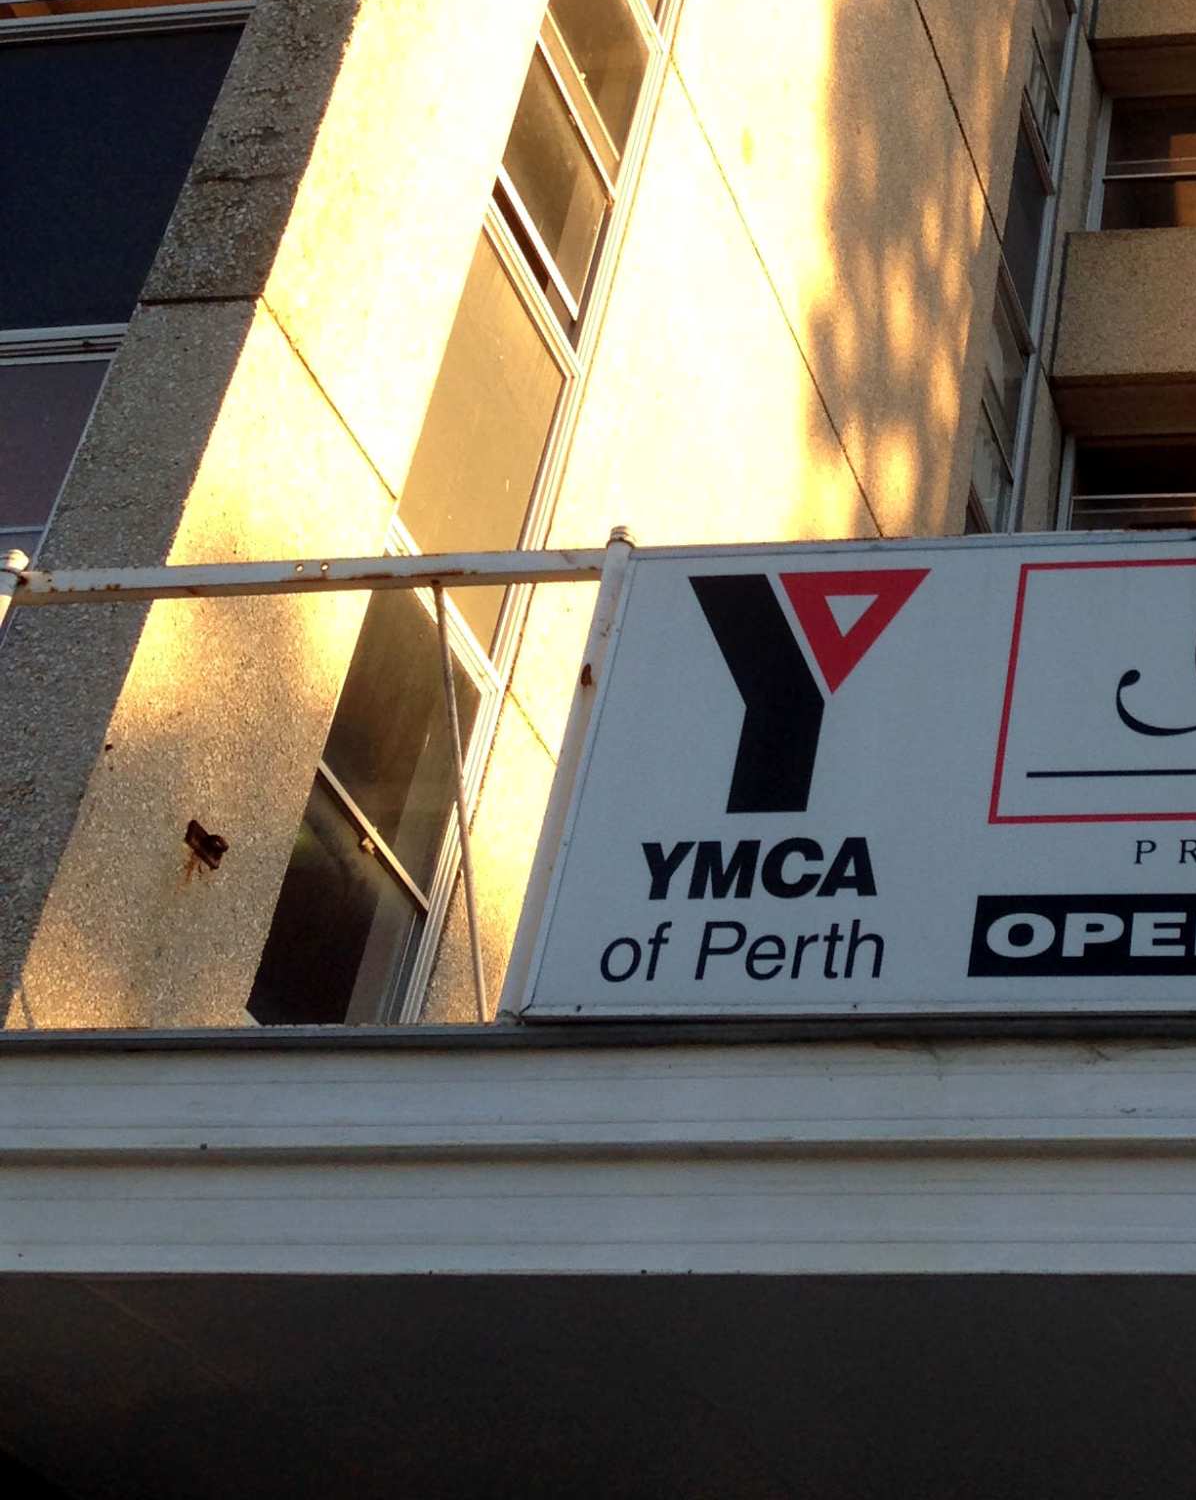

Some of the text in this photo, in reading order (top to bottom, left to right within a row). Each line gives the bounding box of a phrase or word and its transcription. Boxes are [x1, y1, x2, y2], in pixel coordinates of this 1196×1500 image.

[642, 837, 877, 900] YMCA
[601, 919, 885, 982] of Perth
